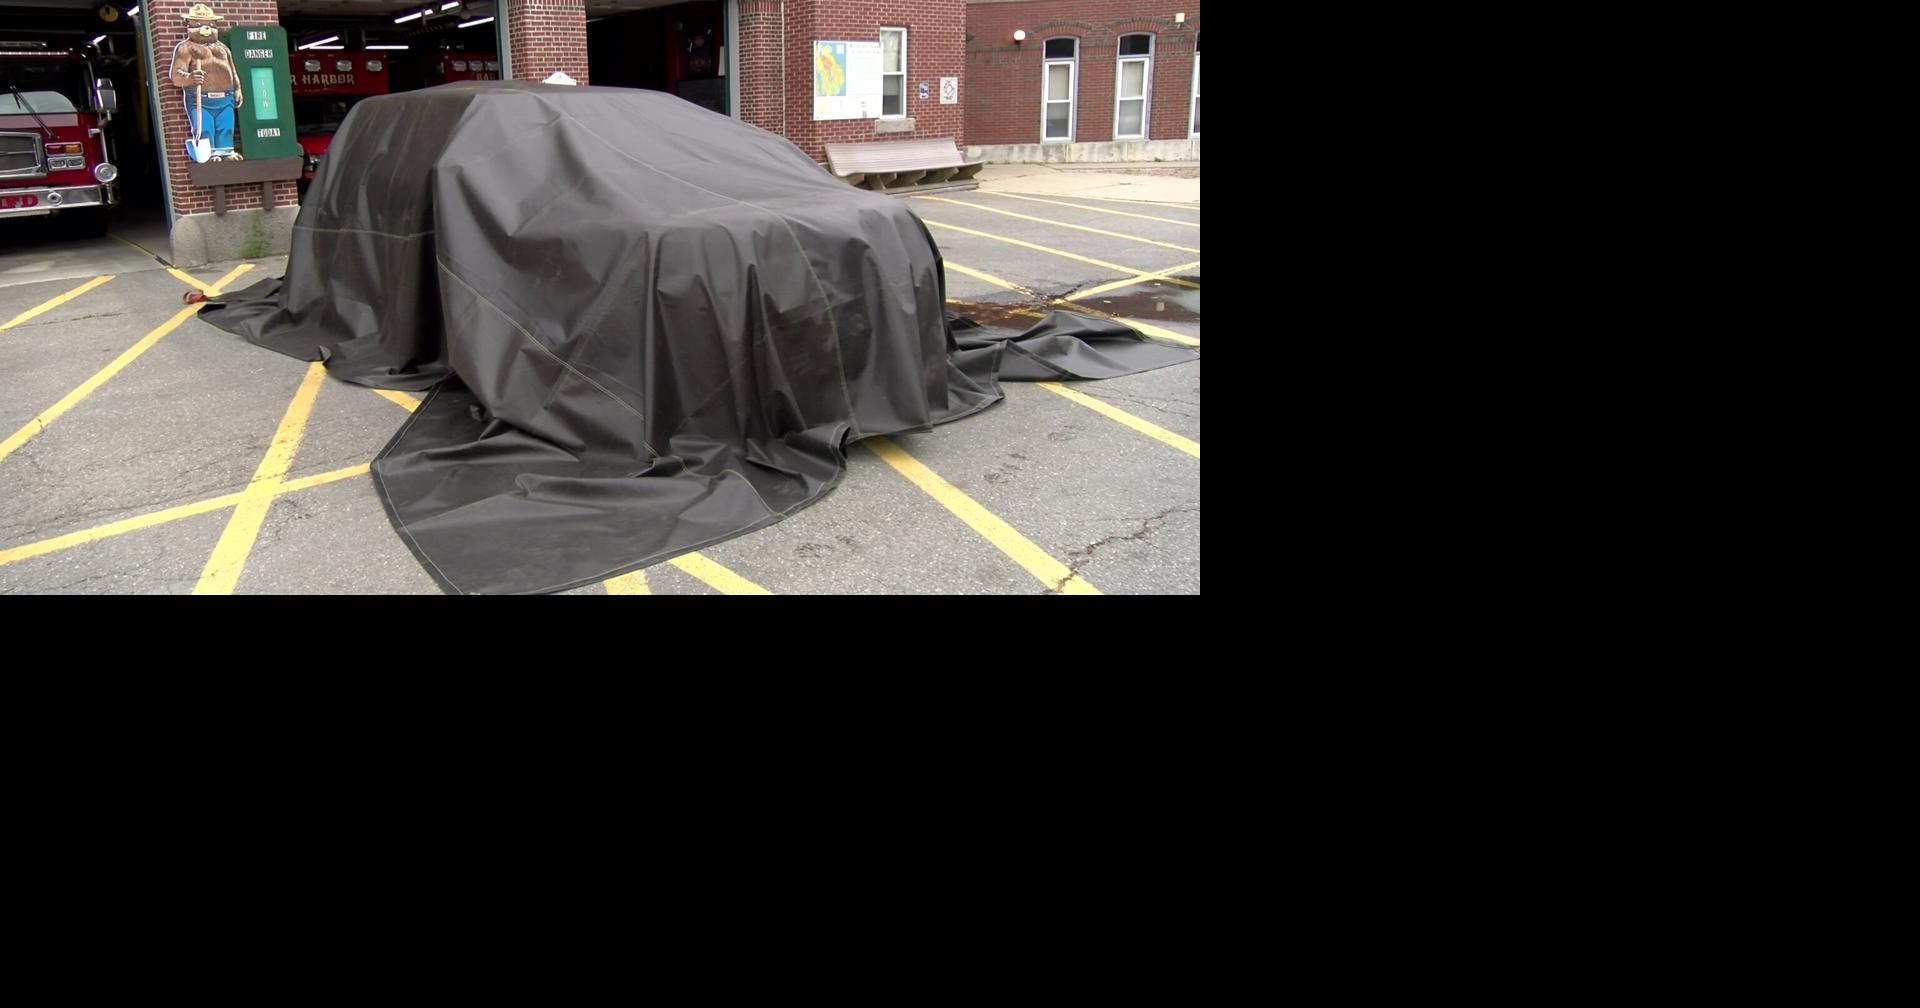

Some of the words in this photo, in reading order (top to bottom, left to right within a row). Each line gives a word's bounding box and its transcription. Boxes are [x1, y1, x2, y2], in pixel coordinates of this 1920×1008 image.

[247, 31, 266, 40] FIRE
[245, 49, 273, 58] DANGER
[302, 74, 355, 86] HARBOR
[260, 79, 270, 108] LOW
[257, 128, 280, 138] TODAY
